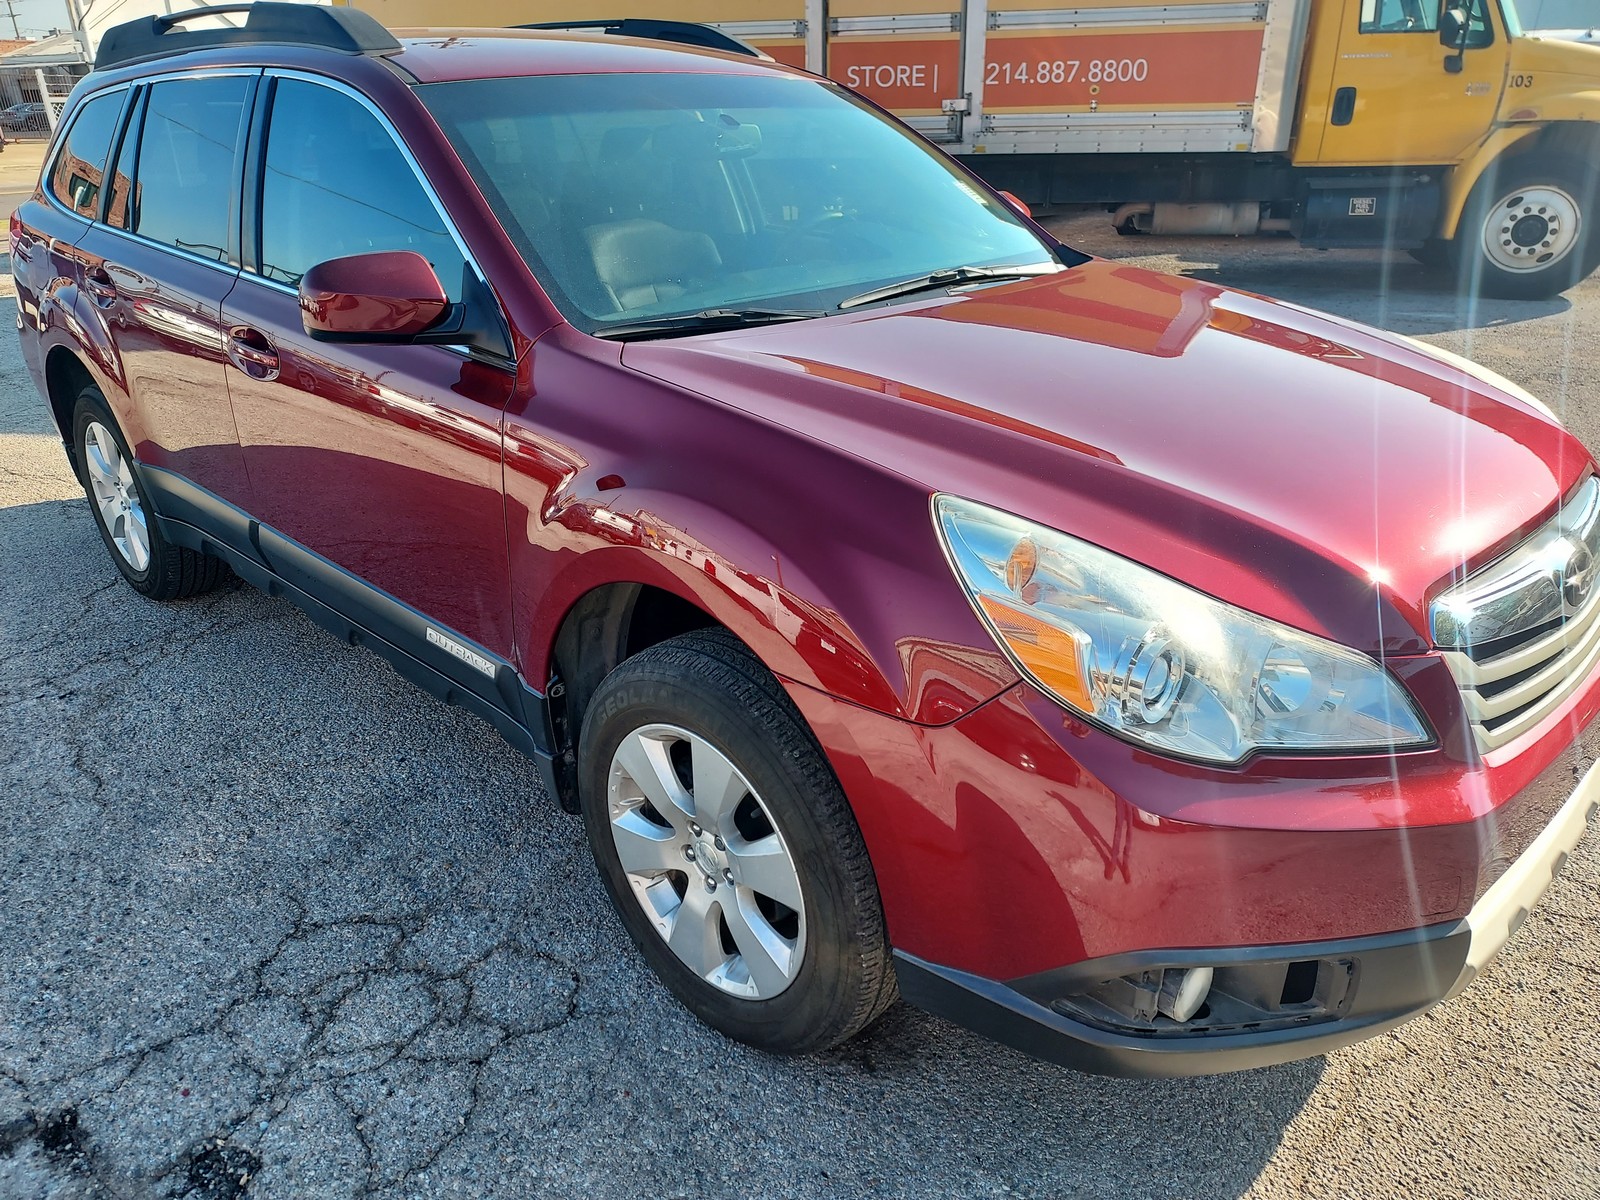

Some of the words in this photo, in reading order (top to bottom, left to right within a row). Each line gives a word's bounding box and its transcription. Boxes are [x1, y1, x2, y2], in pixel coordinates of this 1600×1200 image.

[846, 65, 926, 88] STORE
[985, 58, 1148, 85] 214.887.8800
[1508, 75, 1534, 88] 103
[428, 631, 495, 678] OUTBACK
